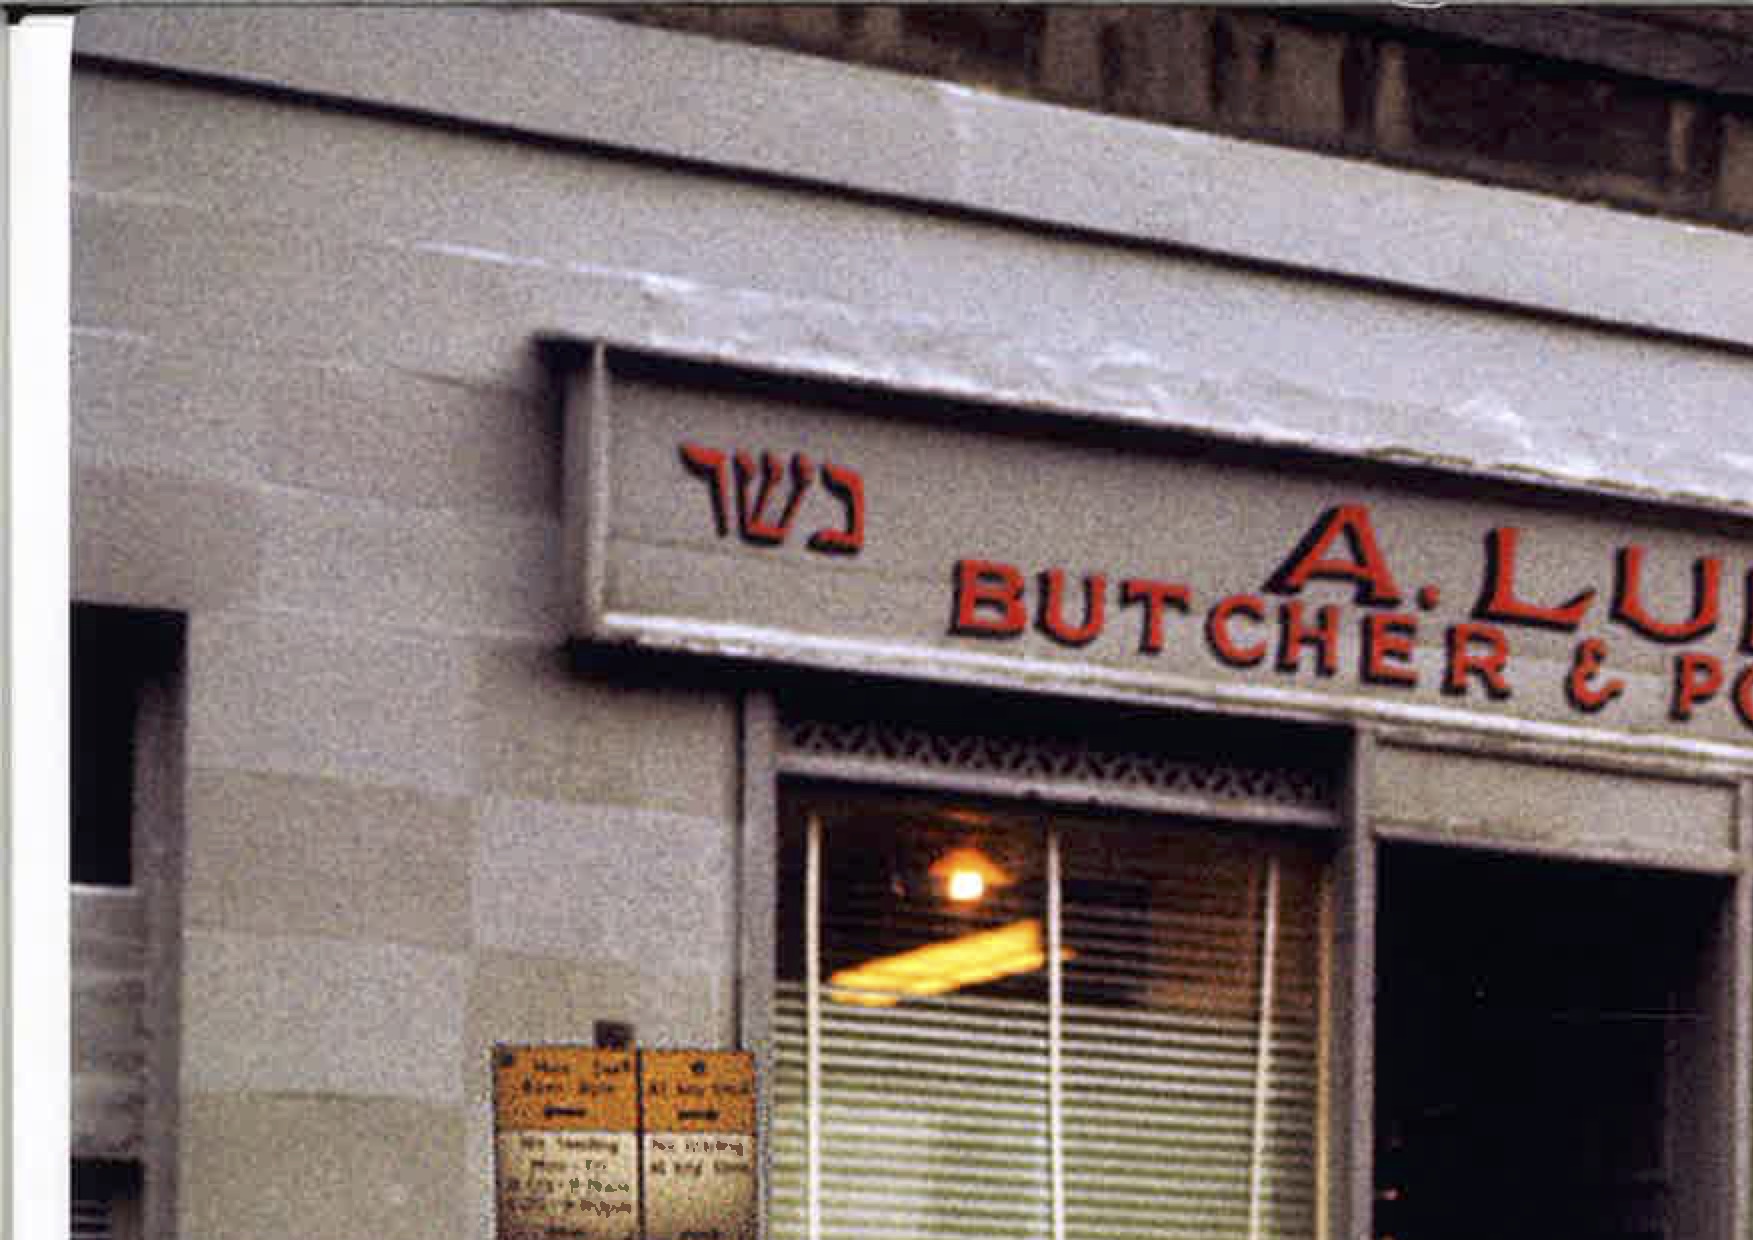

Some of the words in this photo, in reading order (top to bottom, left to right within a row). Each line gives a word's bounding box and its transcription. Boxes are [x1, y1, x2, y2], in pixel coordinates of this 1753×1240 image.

[677, 441, 865, 556] כשר
[950, 557, 1513, 700] BUTCHER
[1564, 635, 1628, 714] &
